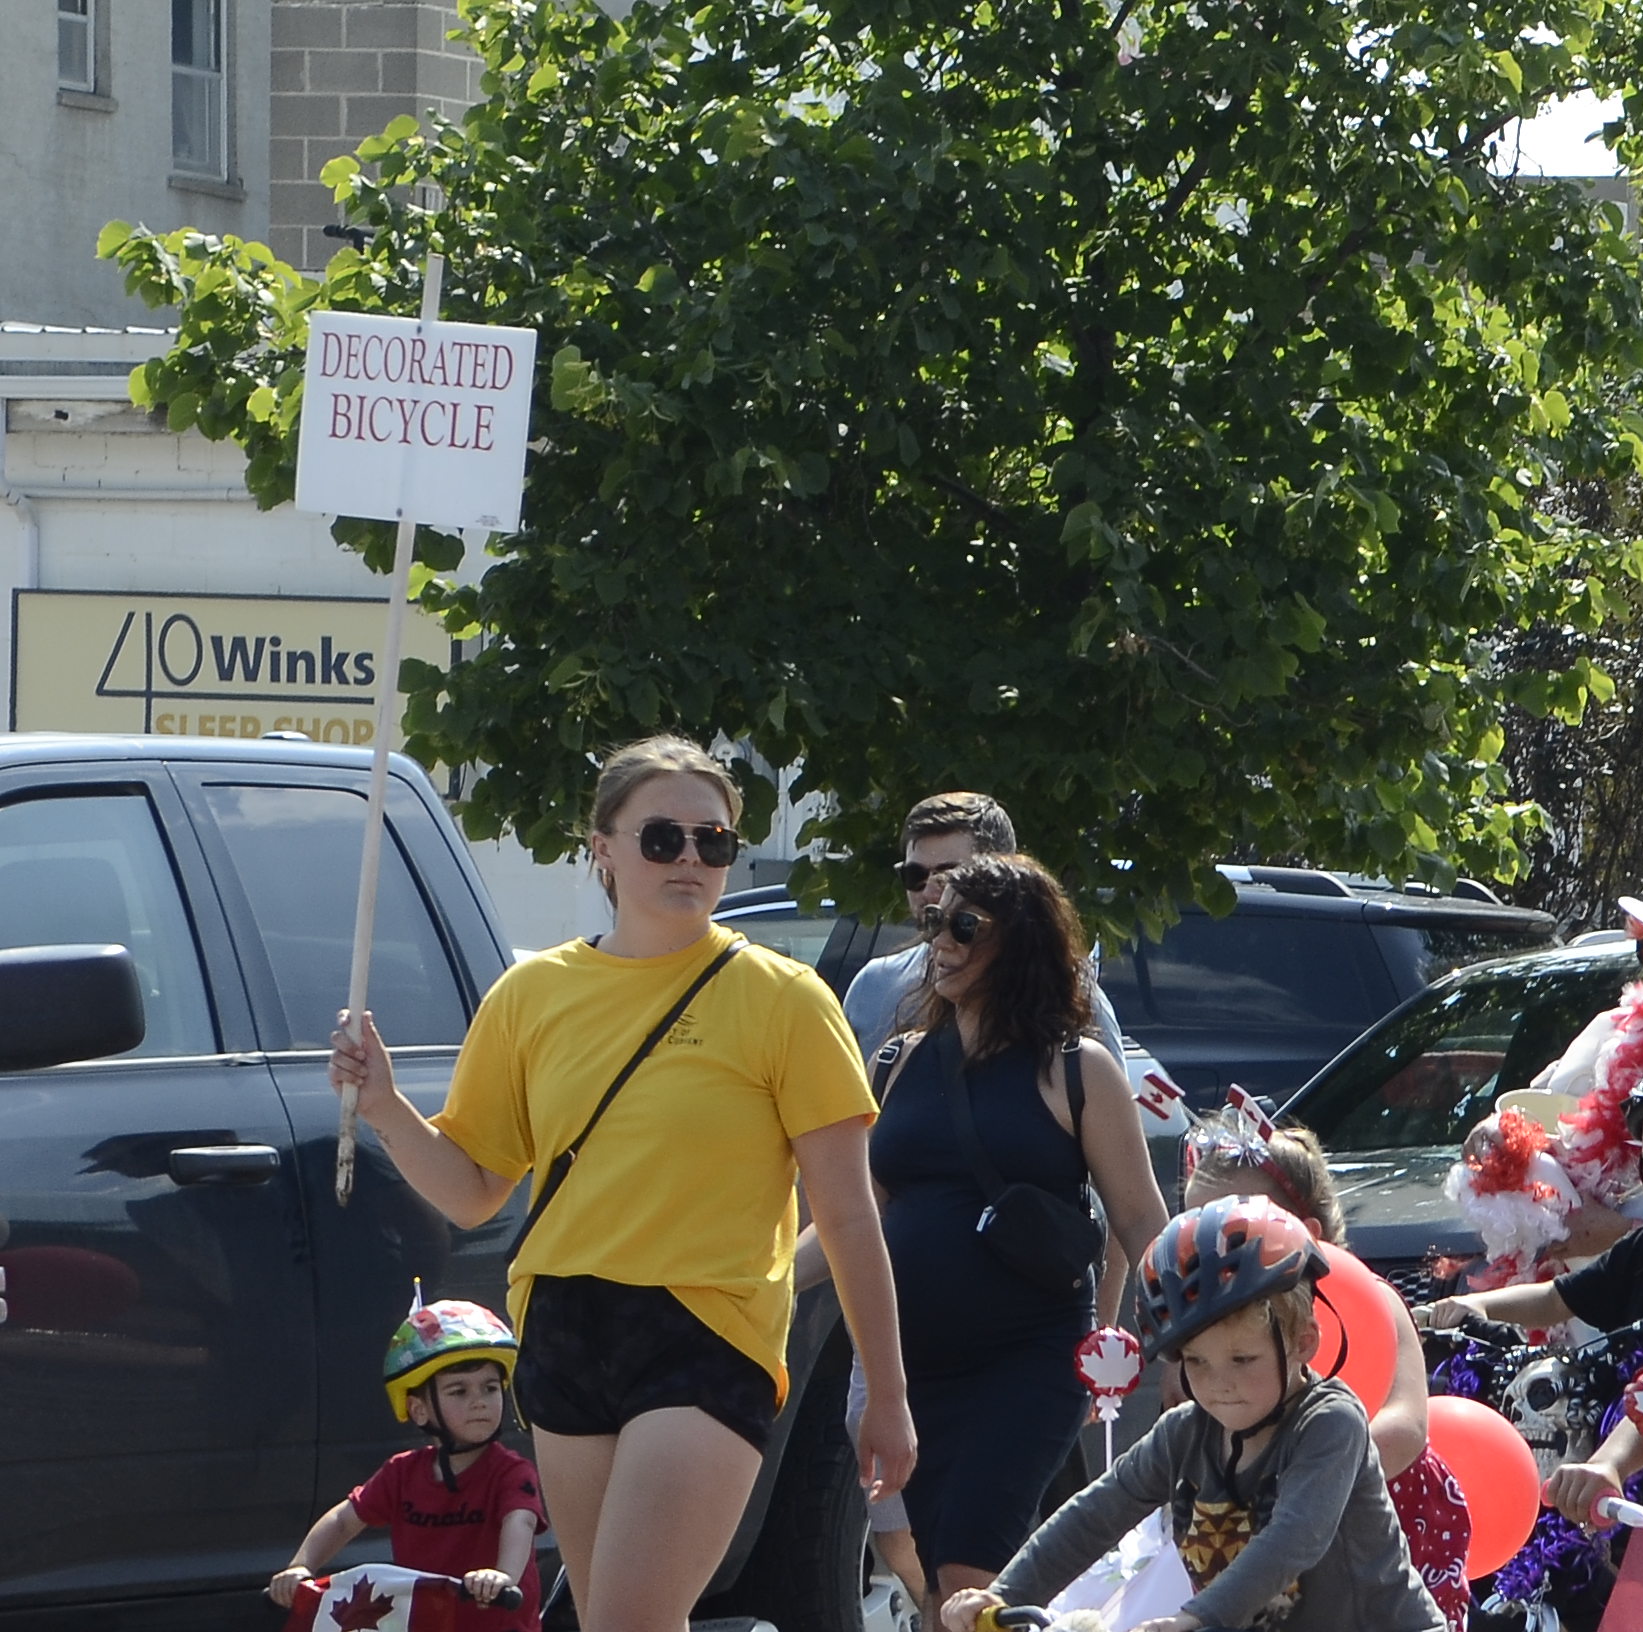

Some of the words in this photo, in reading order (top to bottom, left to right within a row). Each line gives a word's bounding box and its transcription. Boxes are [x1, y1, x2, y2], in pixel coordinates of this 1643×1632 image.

[319, 332, 514, 391] DECORATED
[328, 393, 495, 451] BICYCLE
[210, 635, 376, 686] Winks
[401, 1501, 486, 1527] Canada
